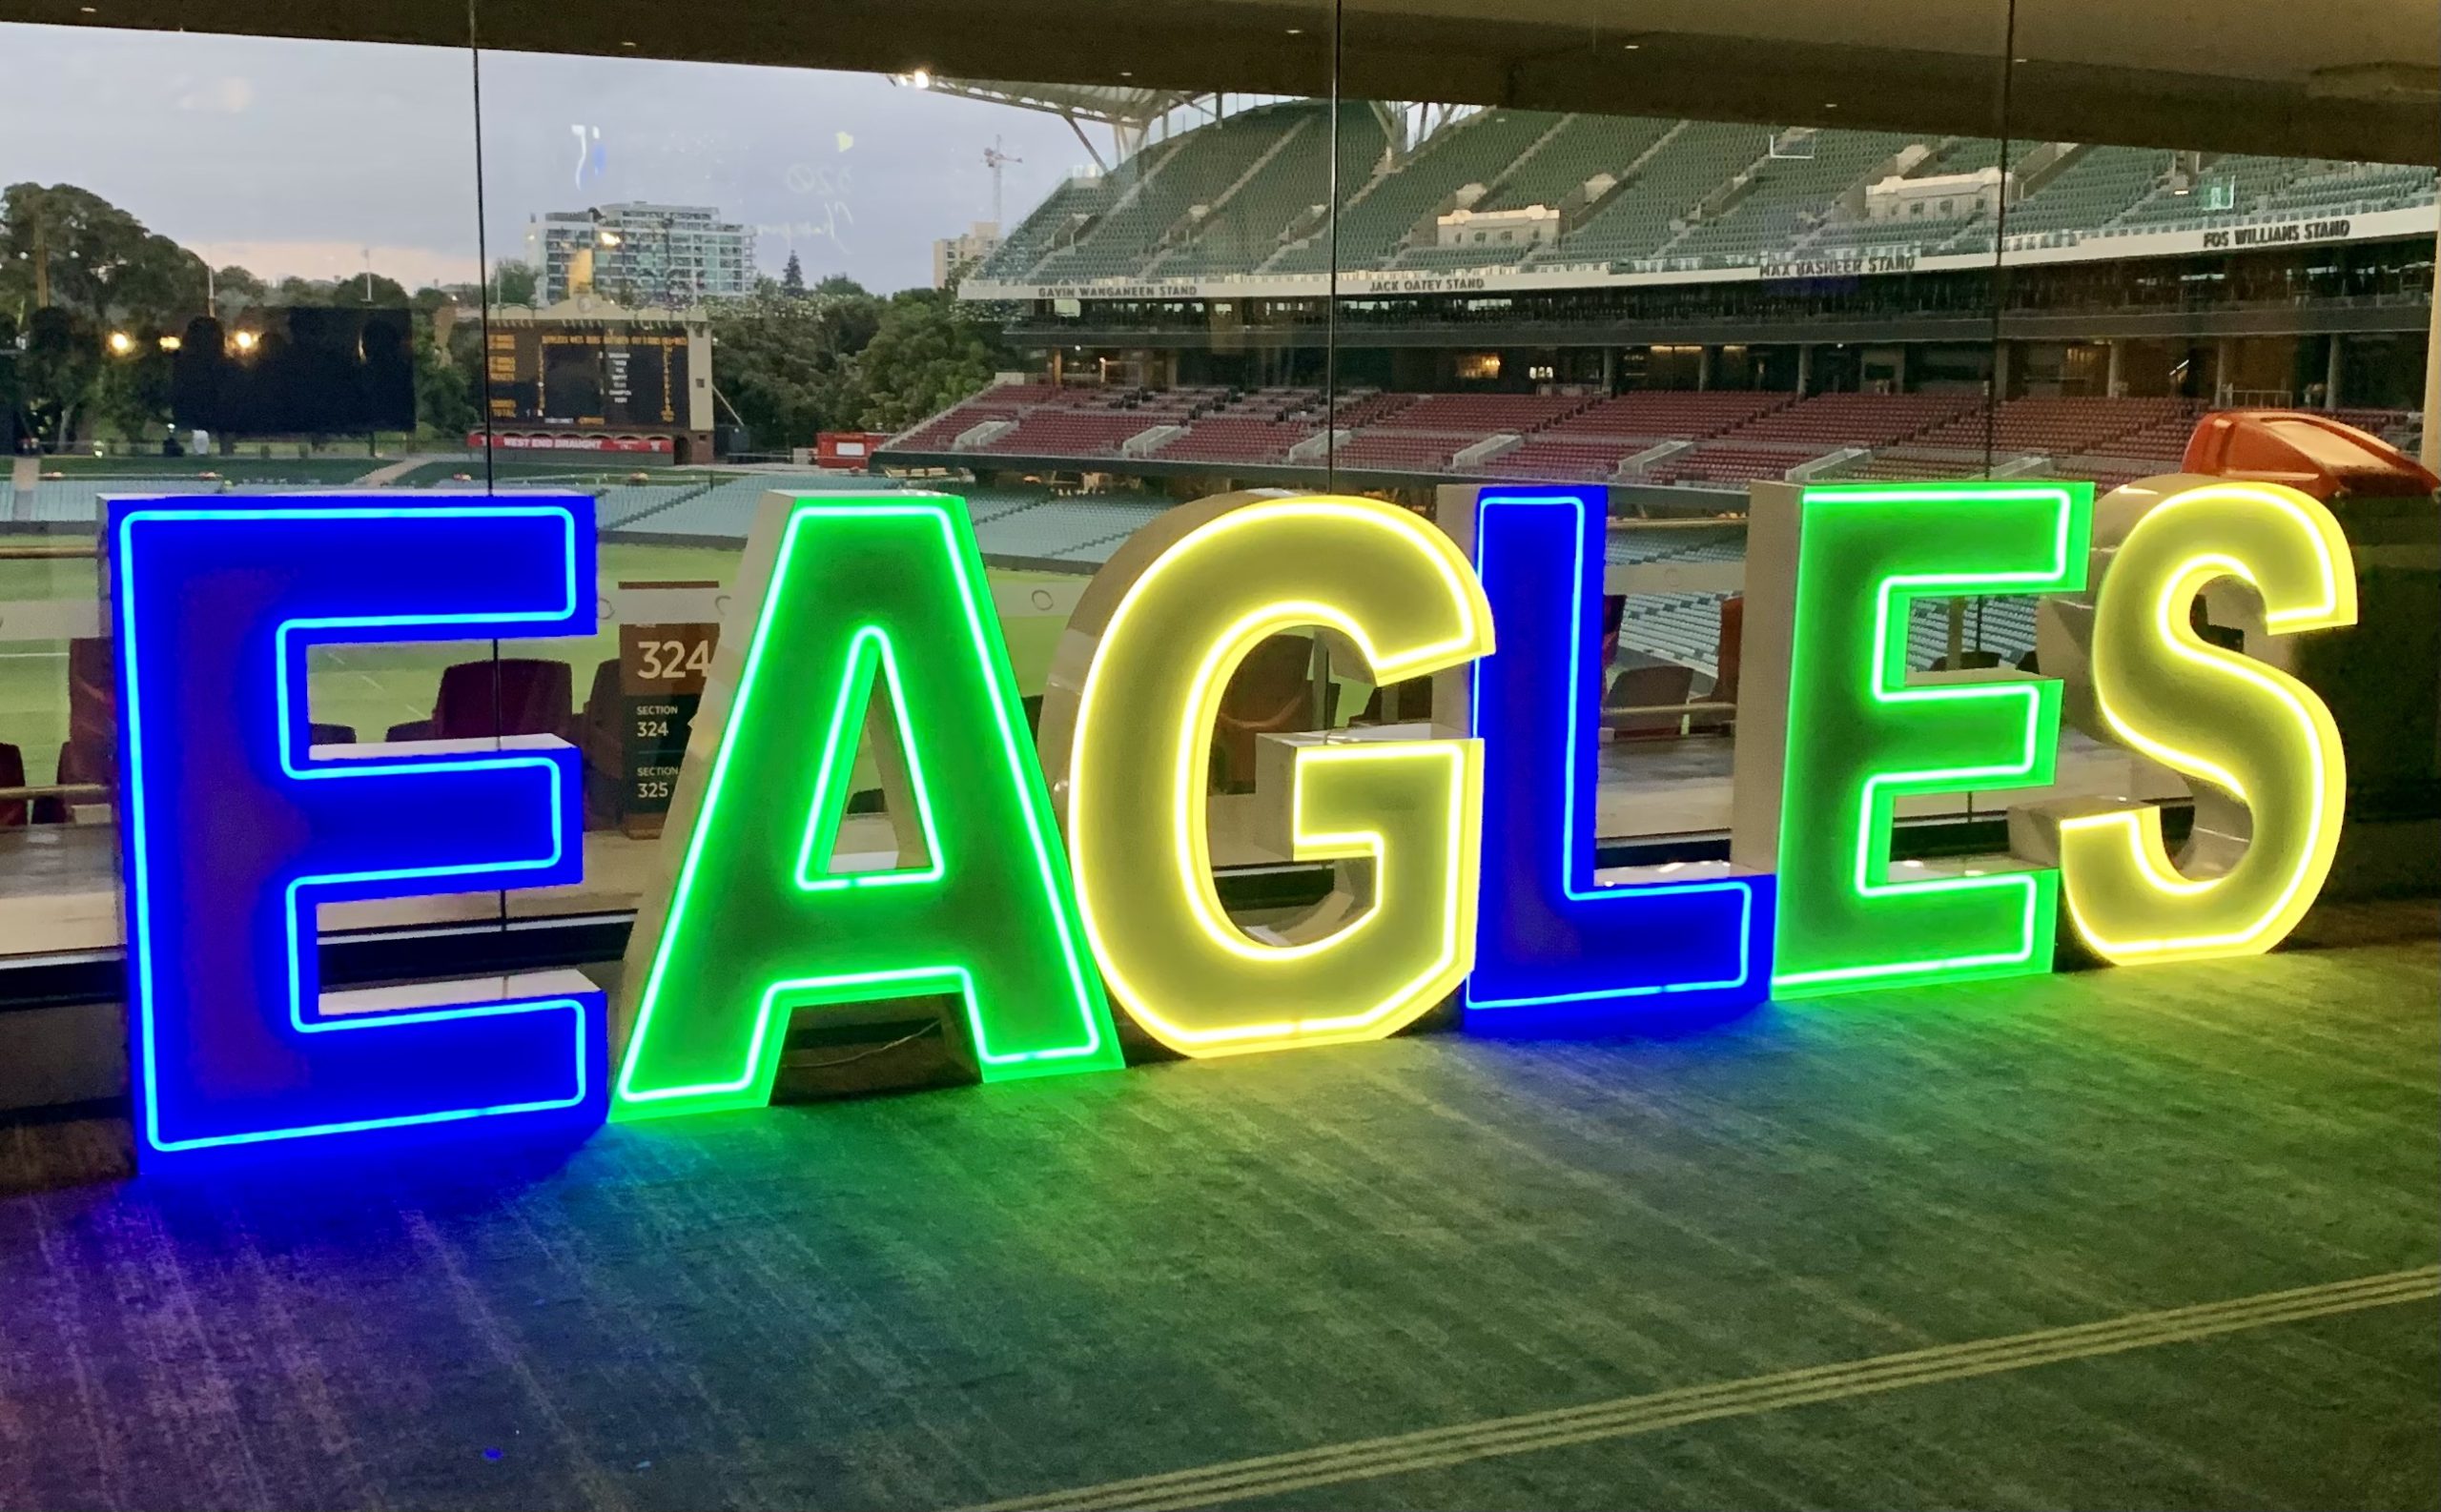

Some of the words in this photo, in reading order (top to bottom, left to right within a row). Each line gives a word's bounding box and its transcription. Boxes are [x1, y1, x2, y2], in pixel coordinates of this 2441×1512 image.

[2203, 231, 2229, 248] FOS
[2234, 224, 2300, 245] WILLIAMS
[2304, 219, 2350, 239] STAND
[1759, 263, 1791, 278] MAX
[1868, 254, 1916, 273] STAND
[1037, 288, 1075, 297] GAVIN
[1078, 288, 1155, 297] WANGANEEN
[1159, 286, 1198, 296] STAND
[1369, 281, 1399, 292] JACK
[1404, 279, 1442, 291] OATEY
[1446, 277, 1485, 290] STAND
[503, 437, 530, 448] WEST
[531, 438, 553, 449] END
[554, 438, 603, 450] DRAUGHT
[637, 640, 710, 680] 324
[636, 705, 678, 716] SECTION
[637, 722, 669, 737] 324
[636, 766, 679, 777] SECTION
[637, 783, 668, 798] 325
[103, 480, 2359, 1176] EAGLES
